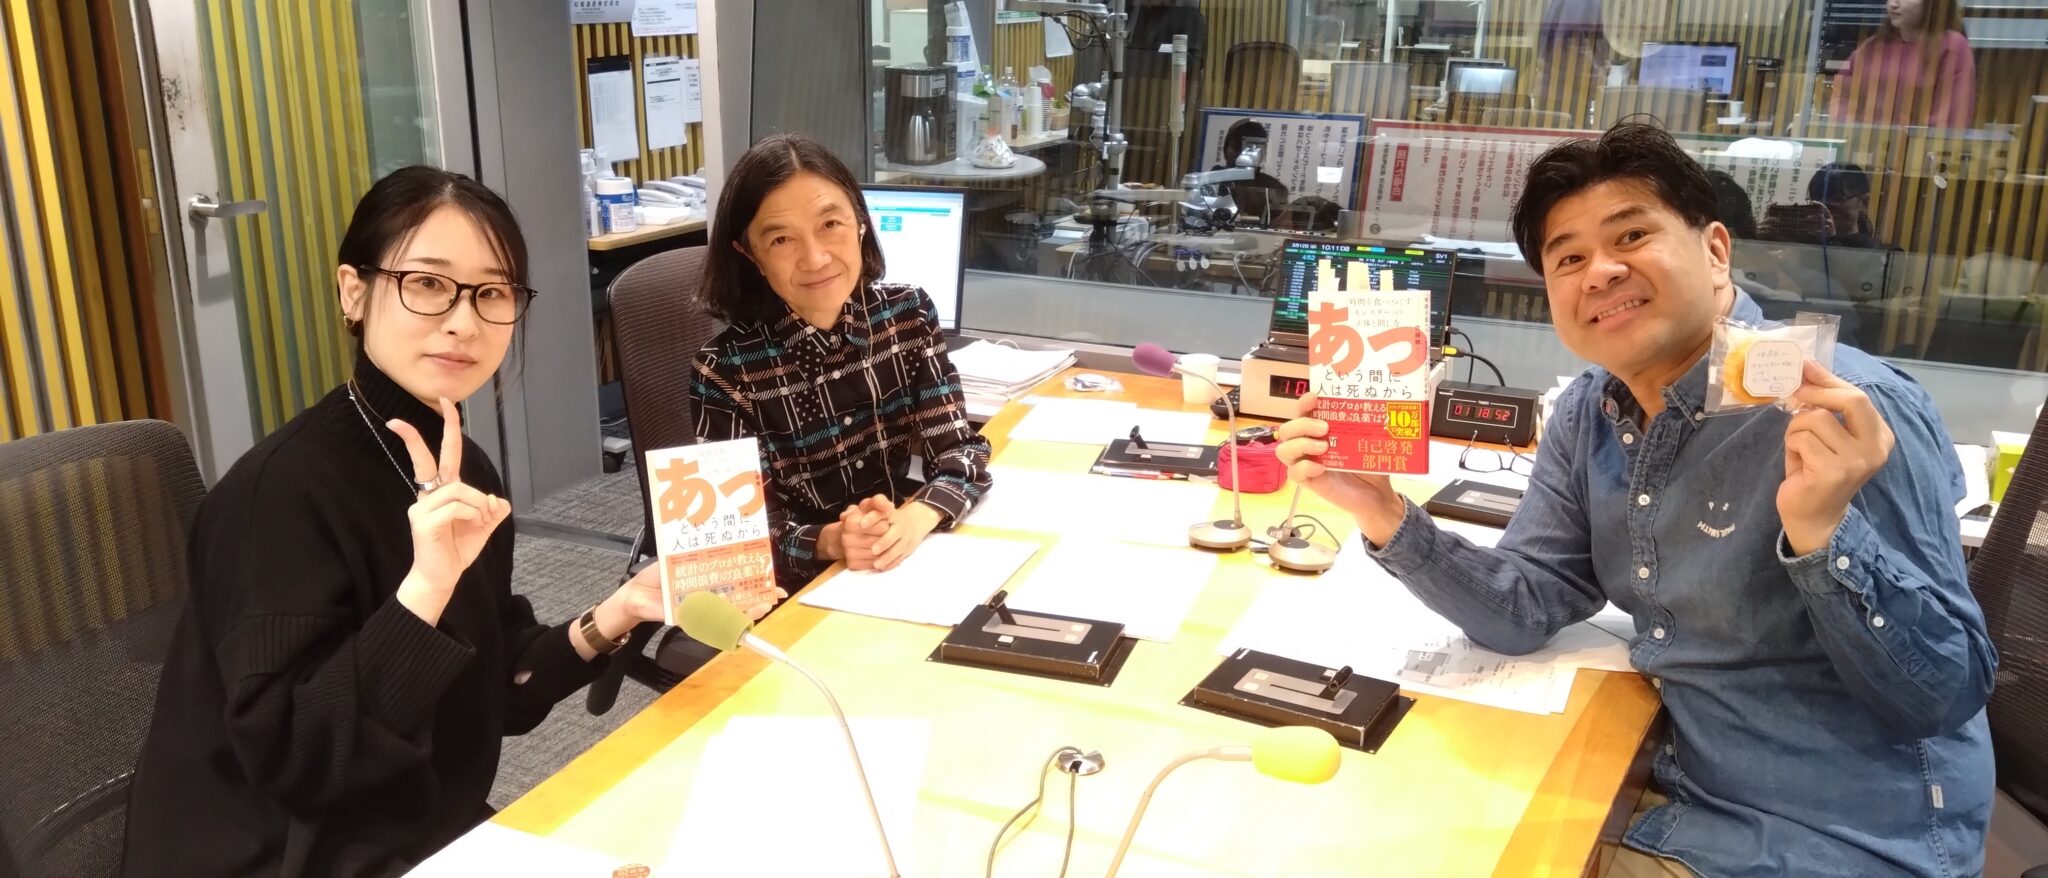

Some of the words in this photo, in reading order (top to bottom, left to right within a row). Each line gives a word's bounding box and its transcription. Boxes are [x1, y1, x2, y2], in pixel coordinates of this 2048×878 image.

[1321, 244, 1350, 252] 10:11:08
[1324, 369, 1401, 383] という間に
[1316, 383, 1413, 399] 人は死ぬから
[1357, 438, 1414, 455] 自己啓発
[1362, 455, 1408, 471] 部門賞
[681, 513, 751, 534] という間に
[672, 526, 762, 552] 人は死ぬから
[675, 552, 766, 577] 統計のプロが教える
